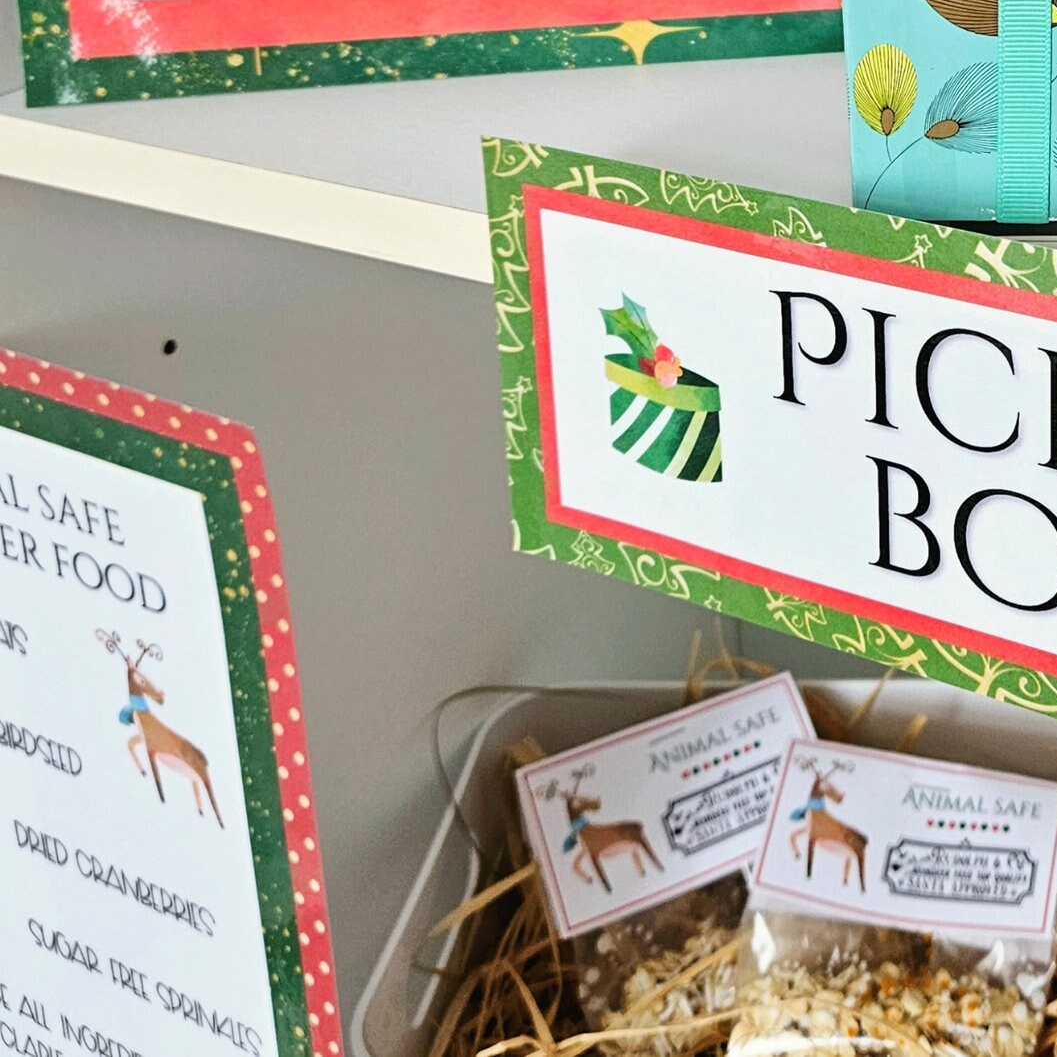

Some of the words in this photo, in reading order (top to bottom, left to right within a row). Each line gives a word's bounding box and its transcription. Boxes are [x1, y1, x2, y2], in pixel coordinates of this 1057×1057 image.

[37, 483, 126, 546] SAFE
[52, 541, 167, 614] FOOD
[649, 726, 733, 774] ANIMAL
[733, 706, 781, 739] SAFE
[901, 783, 989, 815] ANIMAL
[994, 798, 1042, 820] SAFE
[14, 819, 69, 867] DRIED
[76, 849, 217, 938] CRANBERRIES
[19, 995, 51, 1032] ALL
[28, 918, 102, 975] SUGAR
[109, 956, 151, 1004] FREE
[156, 982, 263, 1057] SPRINKLES
